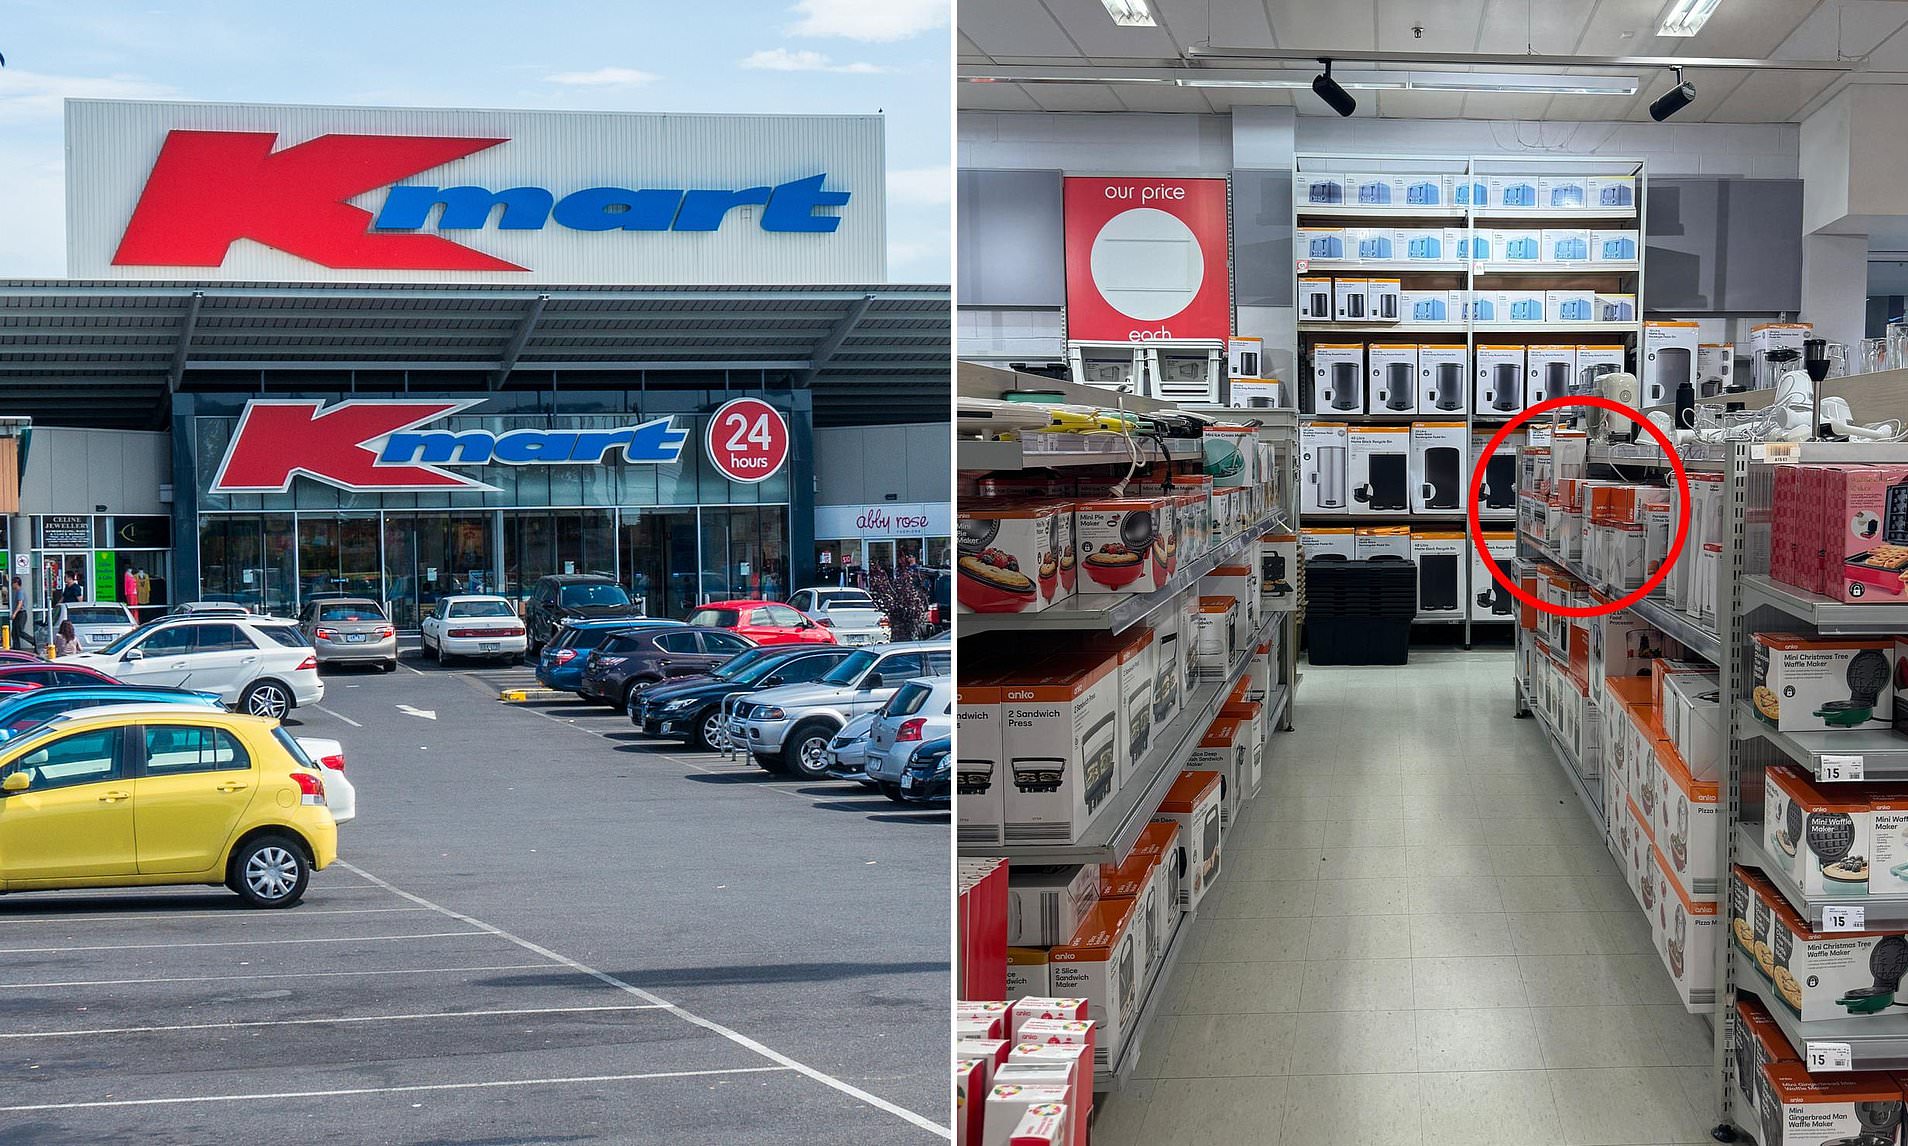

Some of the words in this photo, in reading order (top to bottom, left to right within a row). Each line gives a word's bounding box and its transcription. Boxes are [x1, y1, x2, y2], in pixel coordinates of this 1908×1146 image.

[111, 129, 851, 272] Kmart
[1104, 186, 1135, 200] our
[1142, 183, 1185, 204] price
[1129, 326, 1172, 342] each
[725, 413, 772, 451] 24
[210, 399, 691, 495] Kmart
[730, 453, 768, 468] hours
[856, 509, 890, 534] abby
[895, 515, 929, 528] rose
[1008, 690, 1034, 699] anko
[957, 712, 988, 720] ndwich
[1016, 710, 1060, 718] Sandwich
